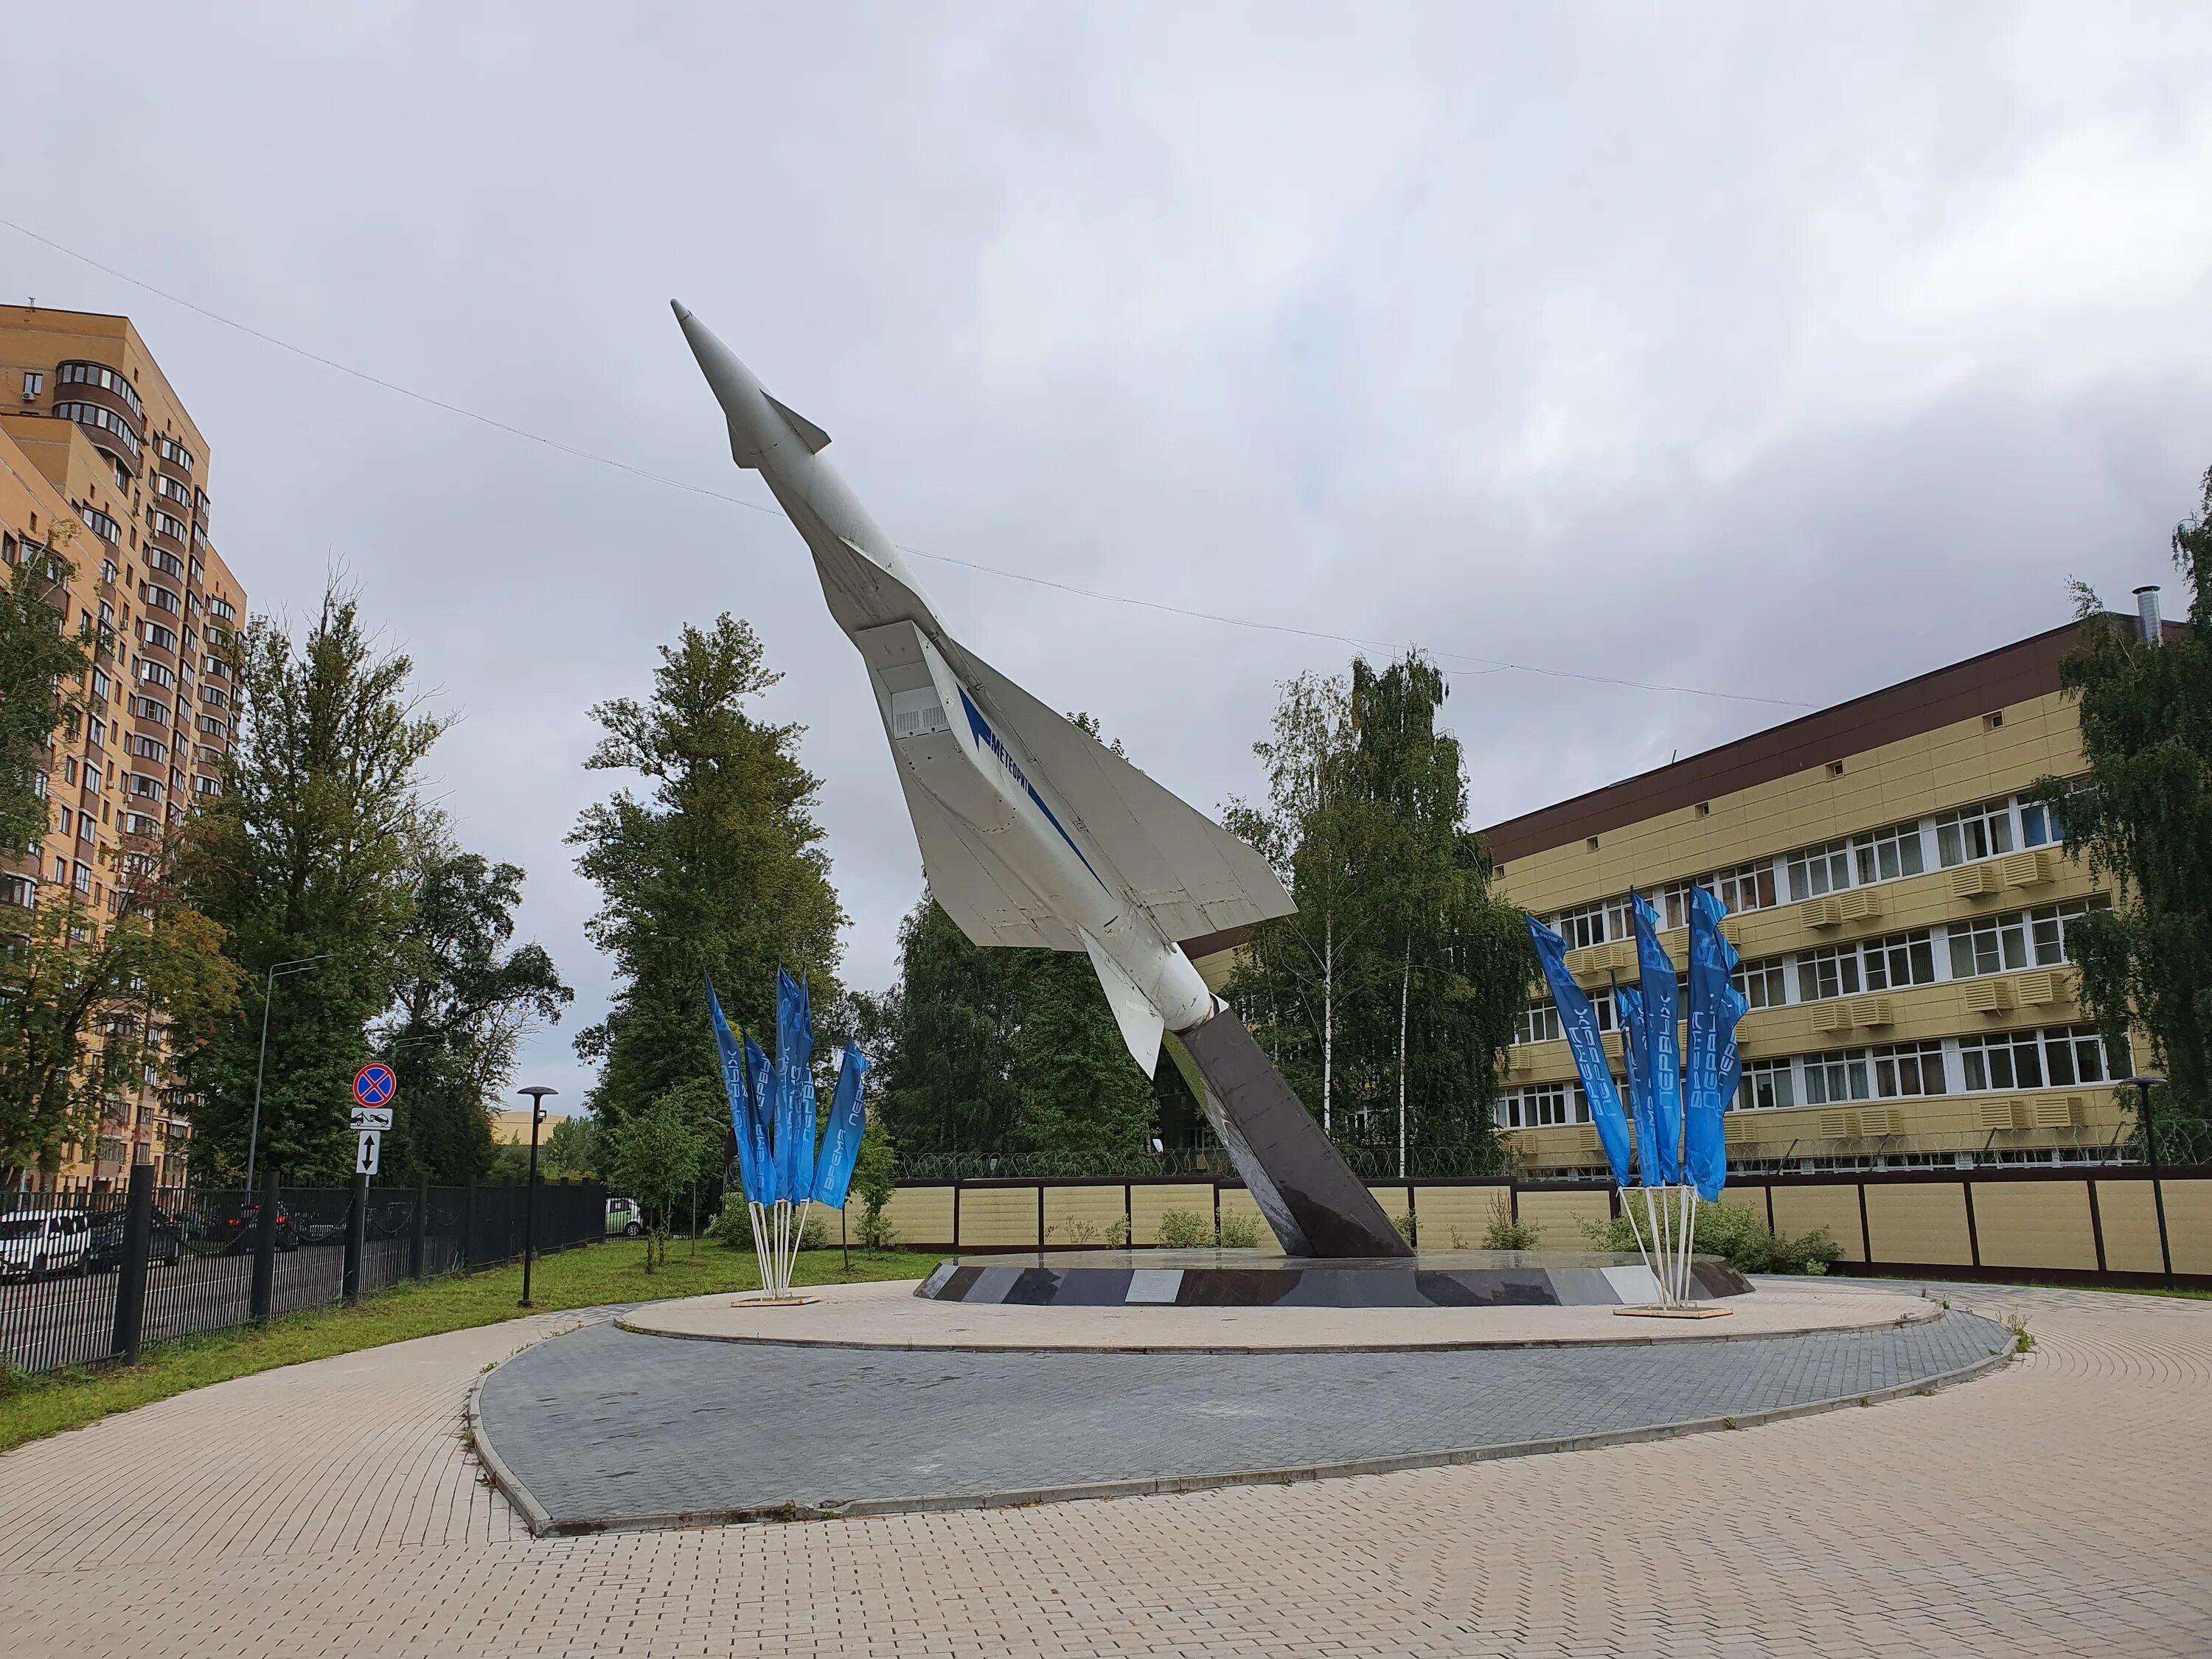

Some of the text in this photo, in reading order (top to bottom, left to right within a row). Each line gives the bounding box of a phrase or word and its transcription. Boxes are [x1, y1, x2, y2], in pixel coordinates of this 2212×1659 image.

[991, 731, 1029, 793] МЕТЕОРИТ
[1568, 1027, 1604, 1116] ВРЕМЯ
[1573, 1008, 1616, 1116] ПЕРВЫХ
[1659, 995, 1673, 1109] ПЕРВЫХ
[824, 1128, 846, 1191] ВРЕМЯ
